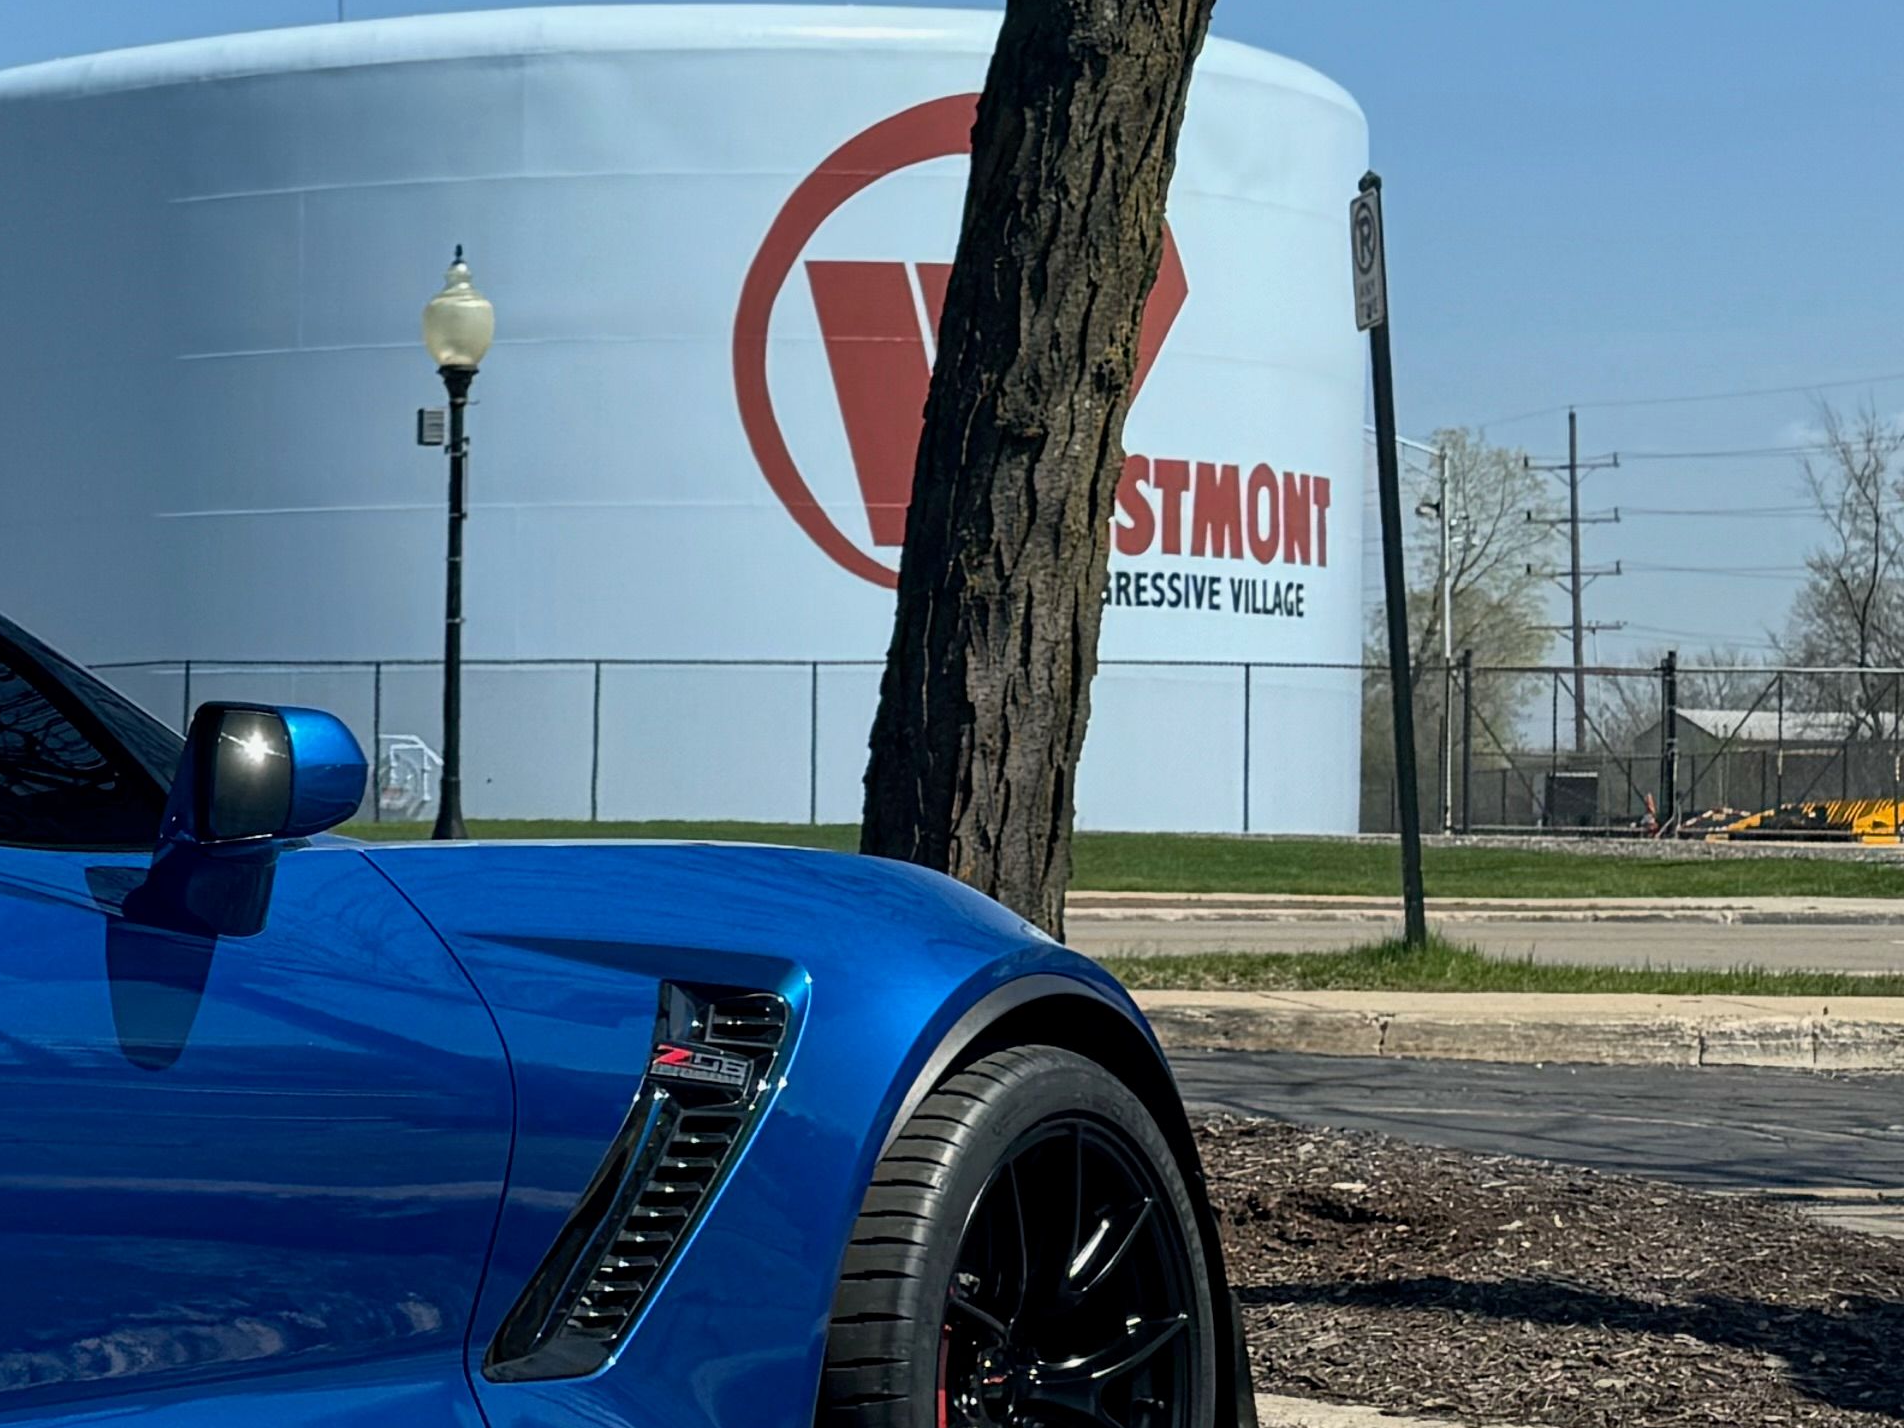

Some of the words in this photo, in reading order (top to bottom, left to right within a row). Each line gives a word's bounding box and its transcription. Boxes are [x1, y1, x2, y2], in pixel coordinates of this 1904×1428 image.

[1110, 453, 1331, 568] STMONT
[1103, 571, 1222, 611] RESSIVE
[1229, 576, 1304, 619] VILLAGE
